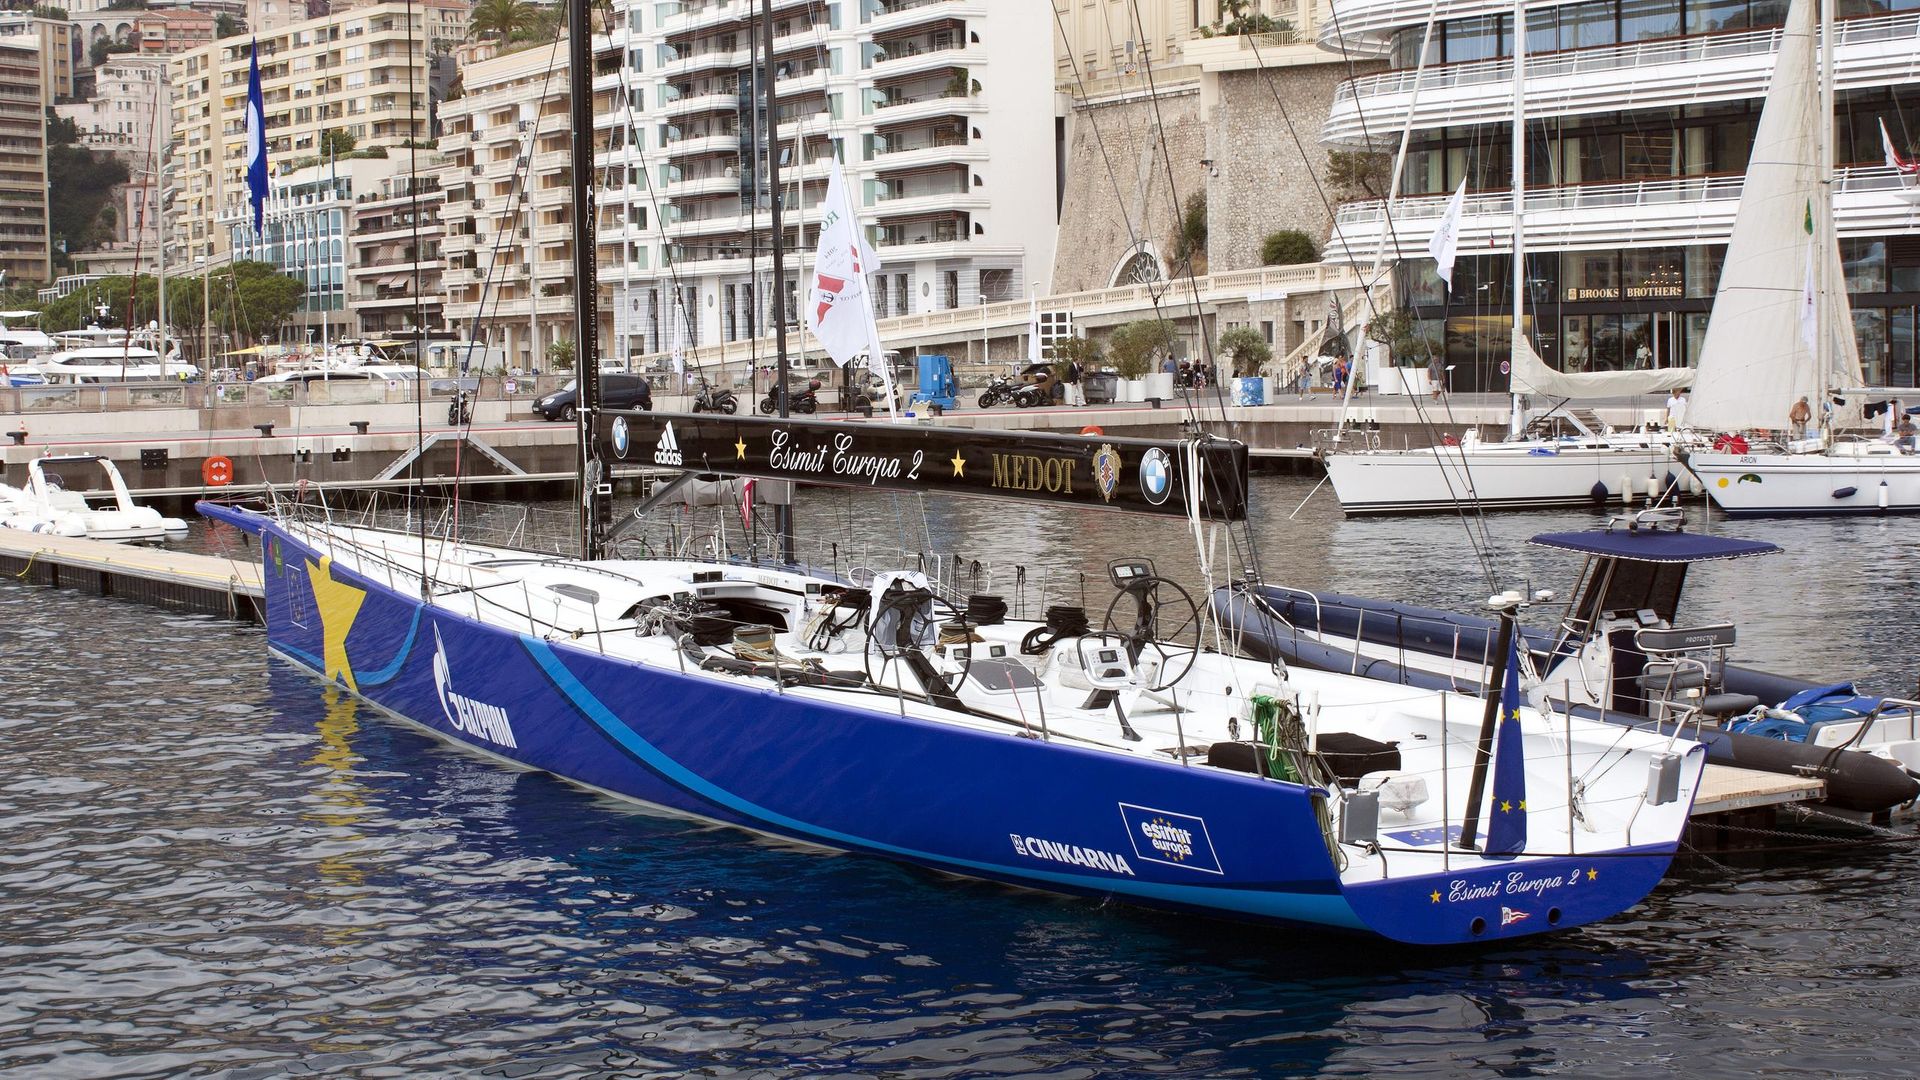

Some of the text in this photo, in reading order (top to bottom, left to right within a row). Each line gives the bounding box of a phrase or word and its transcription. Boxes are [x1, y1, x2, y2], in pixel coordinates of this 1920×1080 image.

[1580, 286, 1682, 299] BROOKS BROTHERS
[654, 450, 682, 466] adidas
[769, 429, 924, 485] Esimit Europa 2
[1740, 456, 1757, 464] ARION
[991, 453, 1076, 494] MEDOT
[1685, 634, 1717, 643] PROTECTOR
[457, 693, 518, 749] GAZPROM
[1141, 821, 1192, 845] esimit
[1025, 836, 1135, 876] CINKARNA
[1152, 838, 1193, 856] europa
[1449, 868, 1580, 903] Esimit Europa 2
